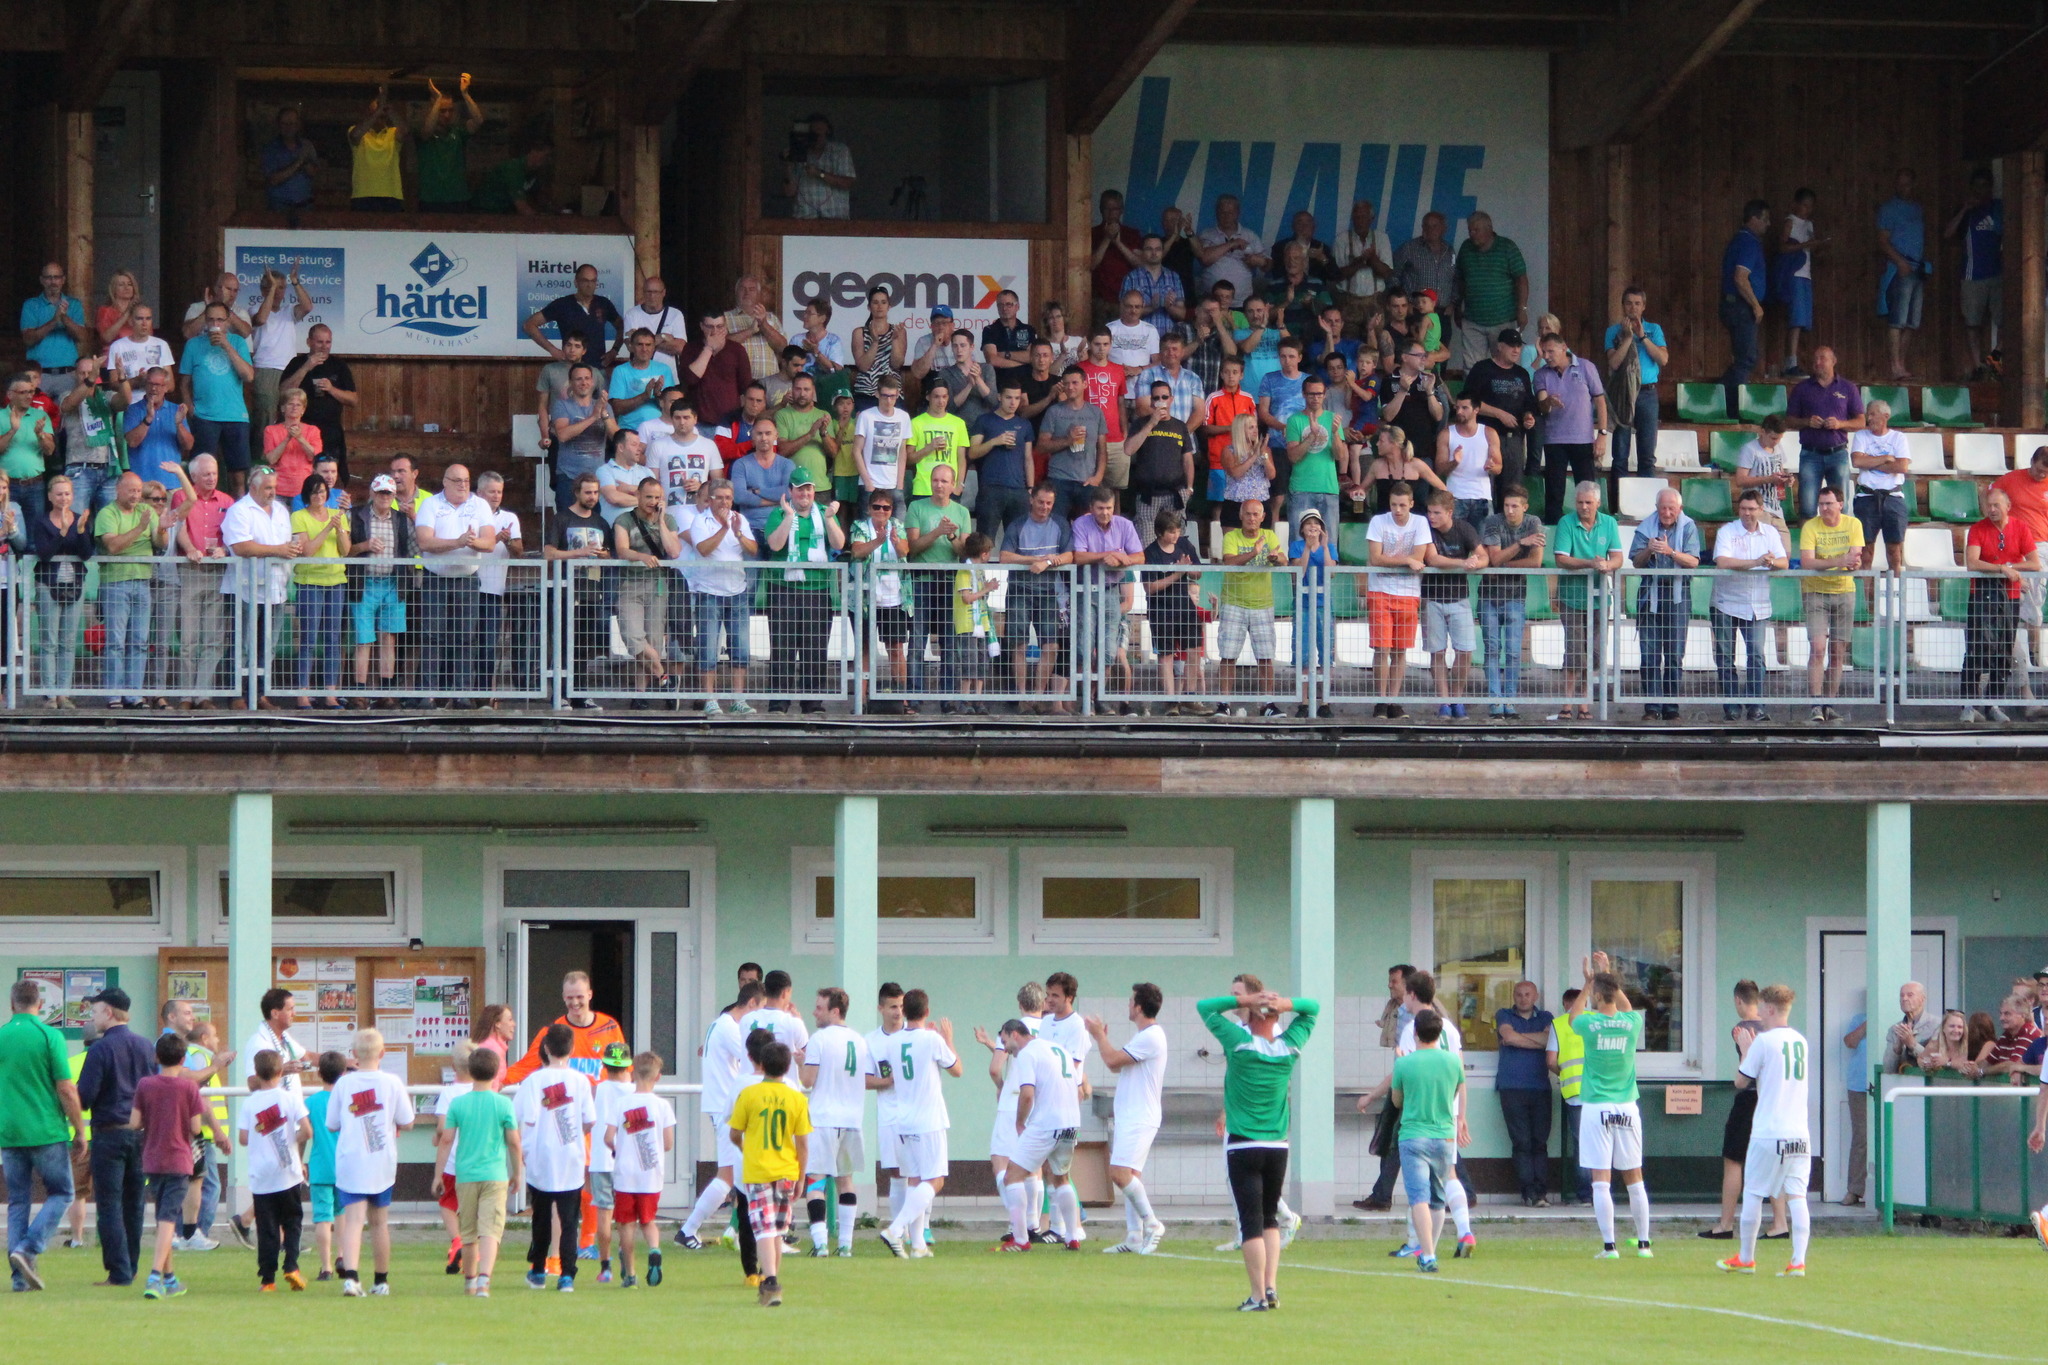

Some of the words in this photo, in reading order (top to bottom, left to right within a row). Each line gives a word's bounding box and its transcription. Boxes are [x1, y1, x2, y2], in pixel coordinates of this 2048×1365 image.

[243, 254, 275, 264] Beste
[528, 261, 577, 274] Härtel
[299, 274, 342, 285] Service
[536, 280, 572, 288] A-8940
[376, 283, 488, 319] härtel
[792, 270, 1017, 320] geomix
[405, 331, 479, 347] MUSIKHAUS
[1087, 372, 1117, 384] HOL
[1088, 385, 1117, 397] LIST
[1089, 397, 1108, 409] ER
[1816, 536, 1828, 546] GAS
[1828, 534, 1850, 546] STATION
[1597, 1033, 1629, 1054] KNAUF
[845, 1040, 857, 1078] 4
[901, 1042, 915, 1081] 5
[1051, 1046, 1073, 1079] 2
[1782, 1041, 1805, 1081] 18
[759, 1108, 788, 1151] 10
